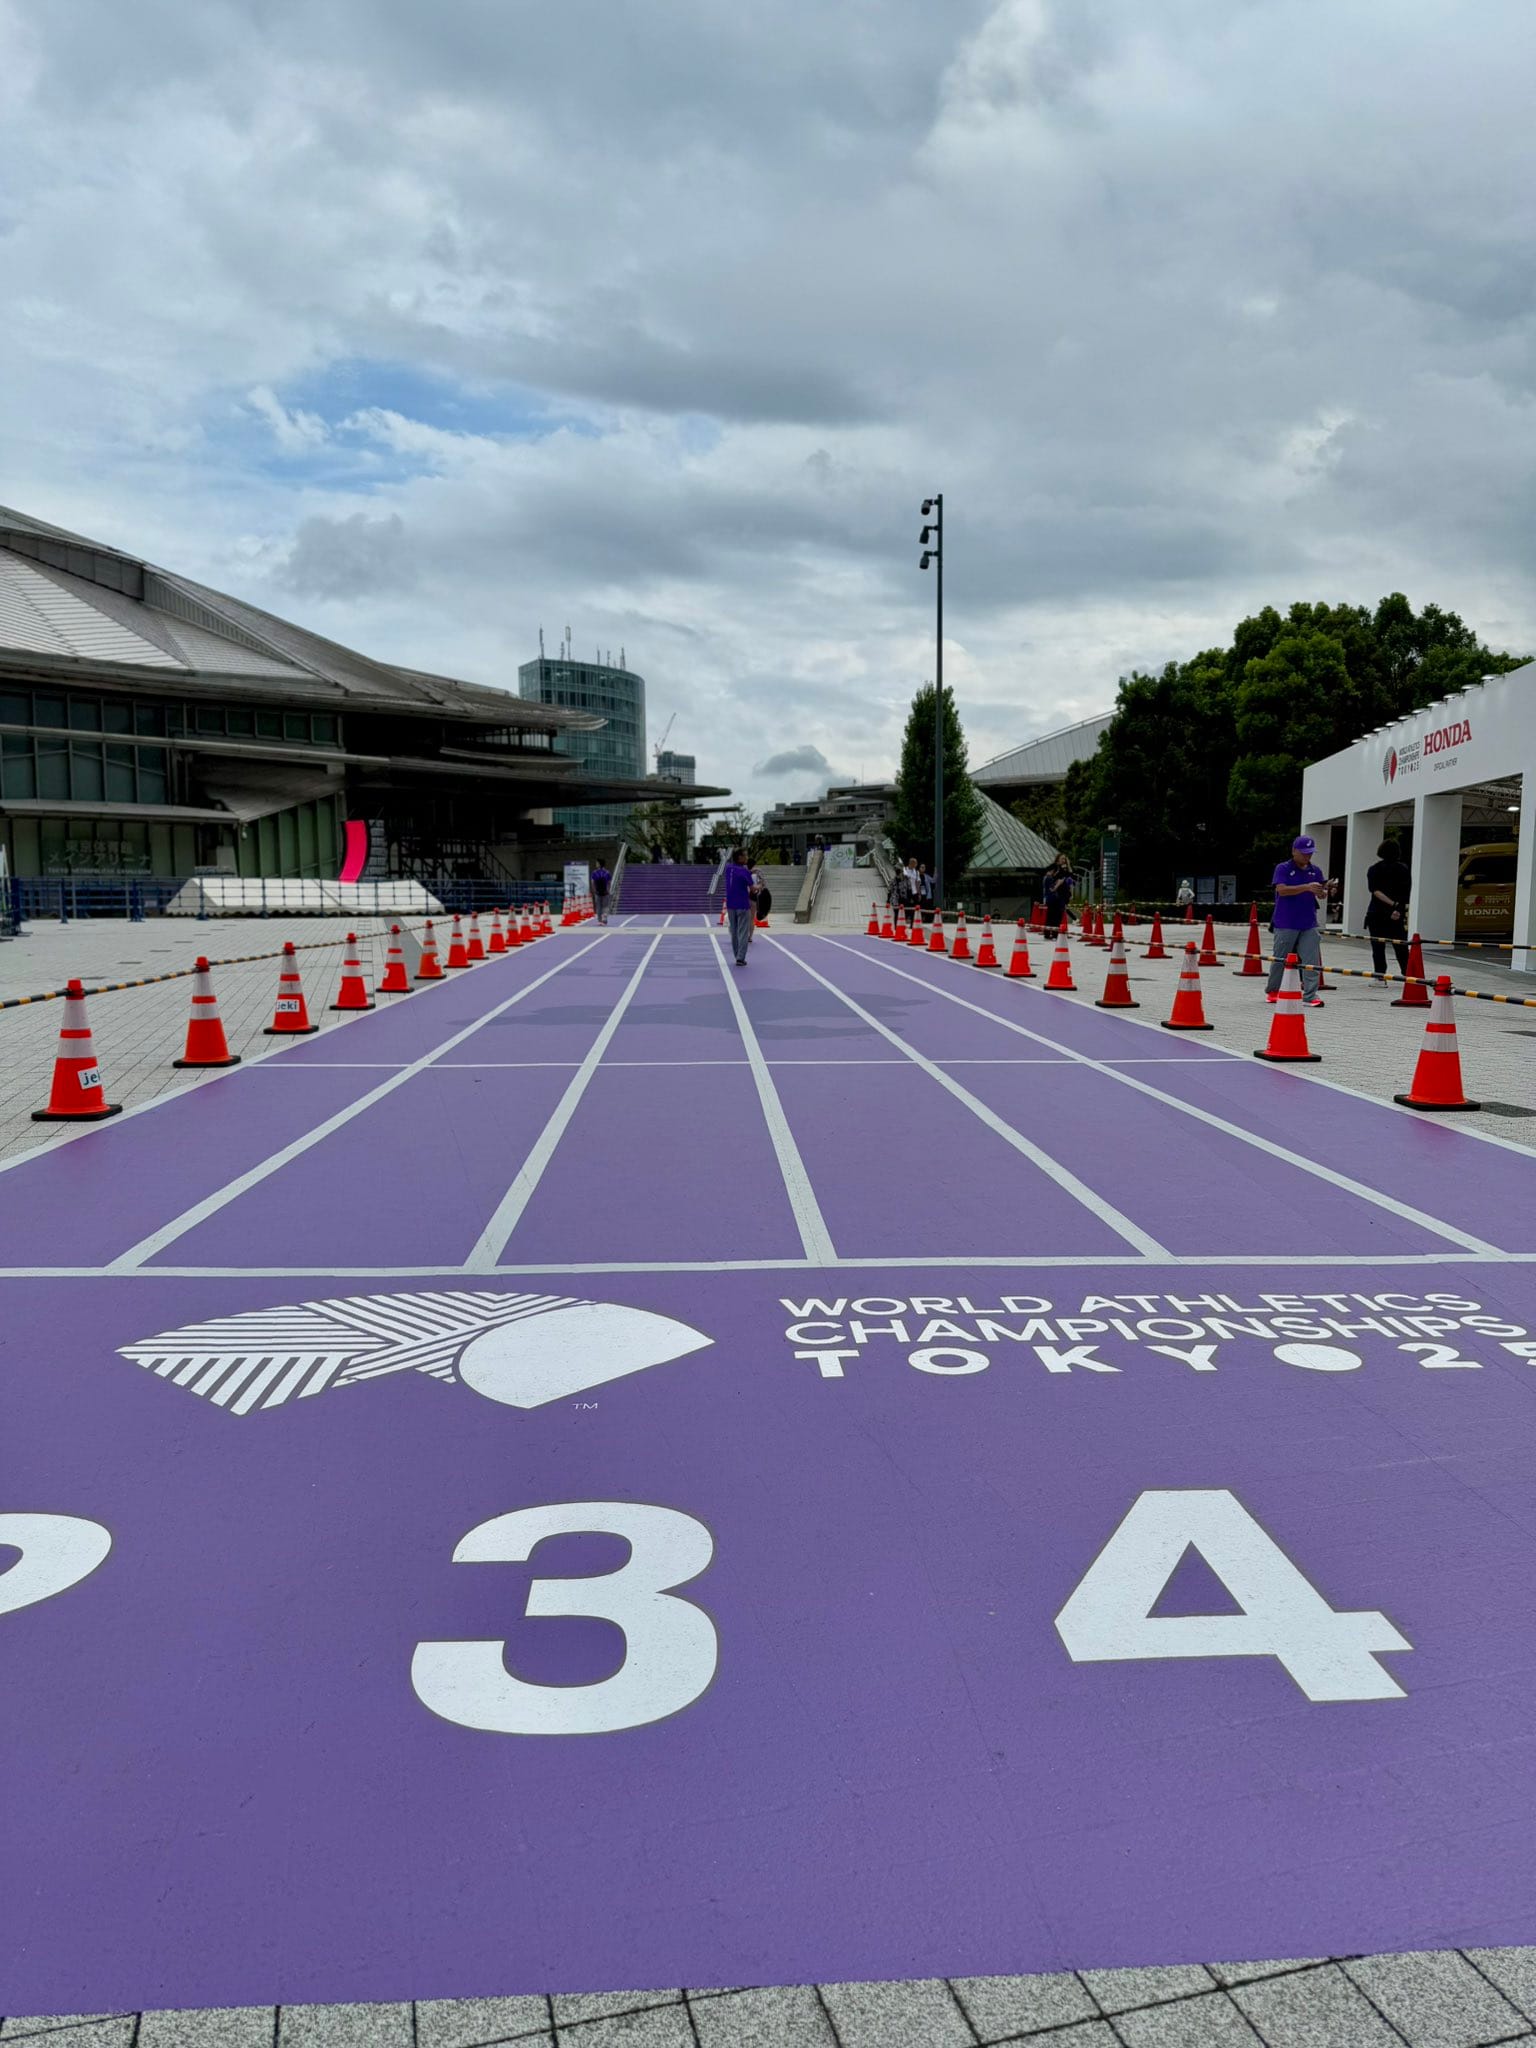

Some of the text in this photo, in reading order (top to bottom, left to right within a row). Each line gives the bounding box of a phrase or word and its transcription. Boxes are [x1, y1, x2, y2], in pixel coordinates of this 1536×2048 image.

[1424, 719, 1472, 756] HONDA
[1464, 908, 1510, 916] HONDA
[83, 1070, 100, 1086] je
[779, 1294, 1482, 1317] WORLD ATHLETICS
[785, 1315, 1527, 1344] CHAMPIONSHIPS
[571, 1402, 598, 1410] TM
[1054, 1489, 1414, 1701] 4
[411, 1501, 718, 1735] 3
